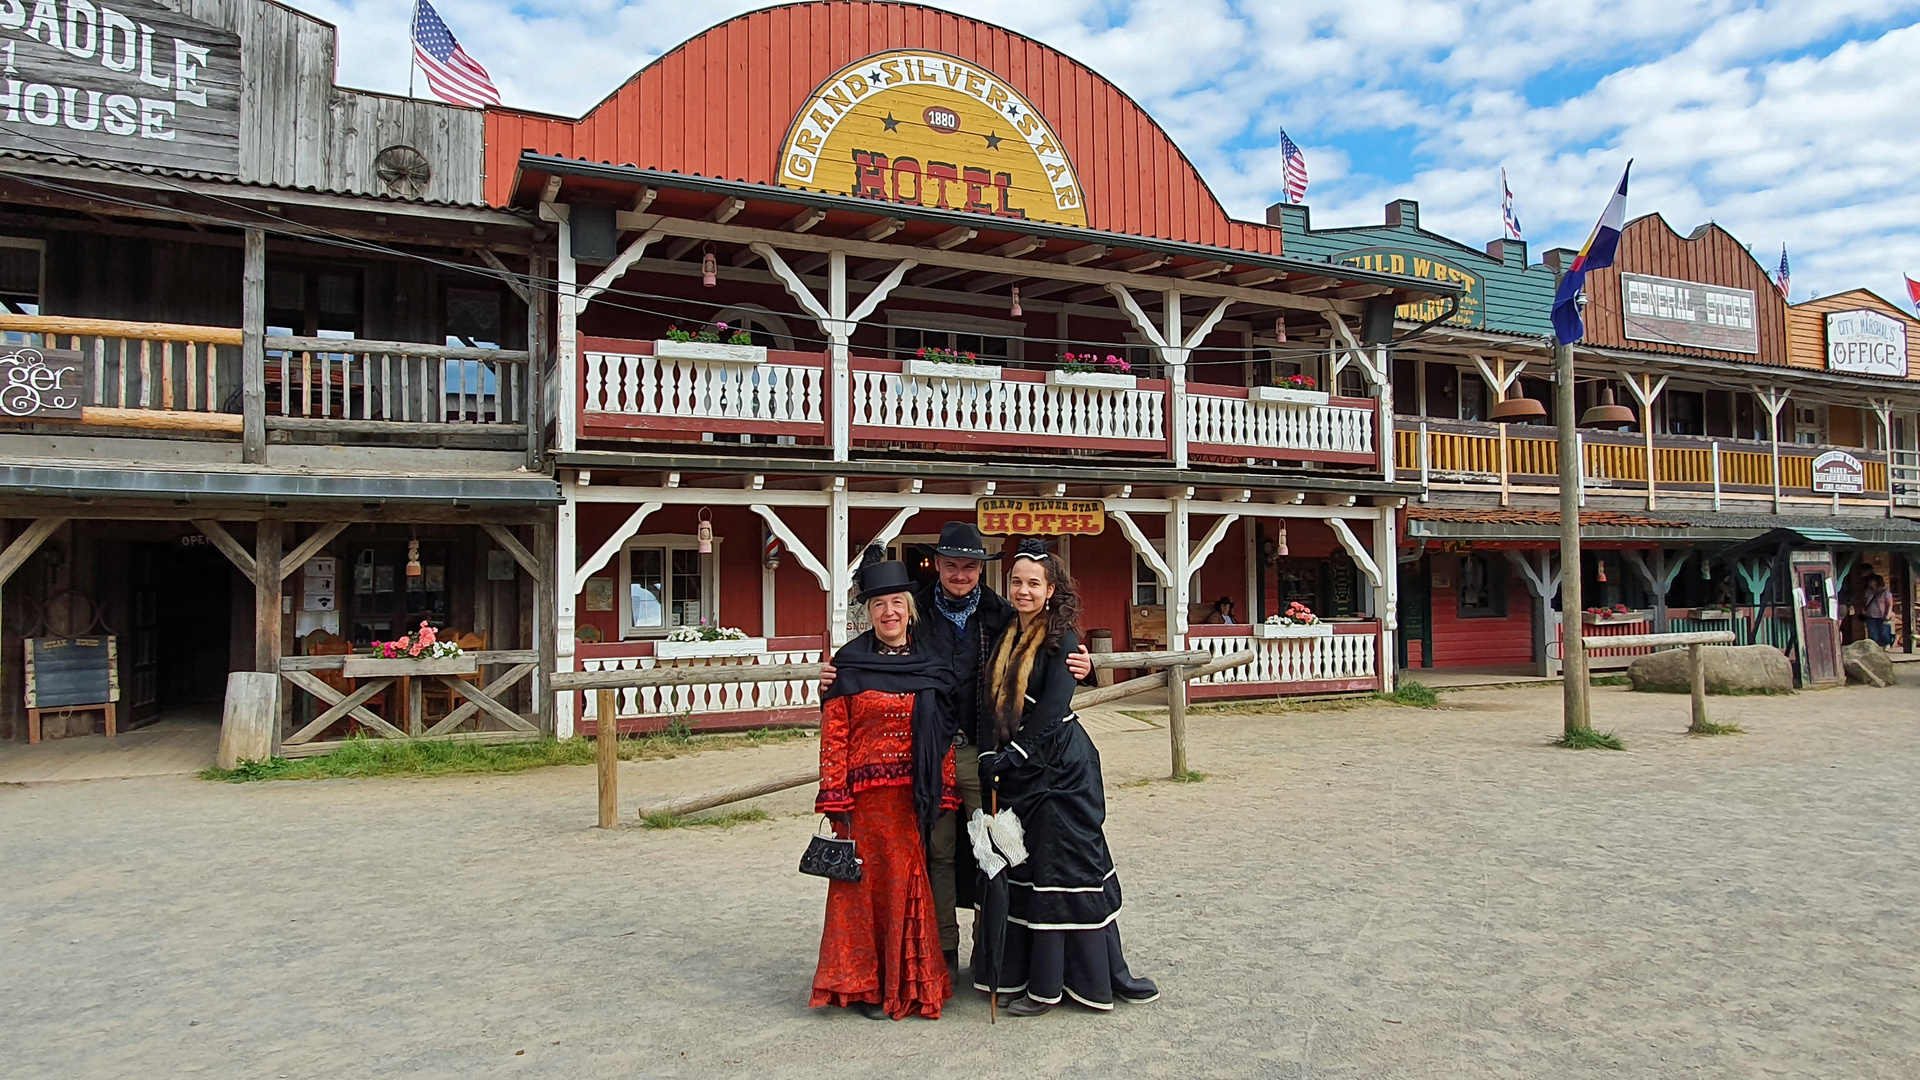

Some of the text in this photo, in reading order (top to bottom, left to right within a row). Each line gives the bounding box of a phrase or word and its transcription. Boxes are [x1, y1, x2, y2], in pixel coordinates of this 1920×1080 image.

[0, 78, 176, 141] HOUSE
[927, 110, 955, 129] 1880
[788, 58, 1077, 209] GRAND SILVER STAR
[852, 148, 1026, 220] HOTEL
[1413, 257, 1476, 294] WEST
[1628, 280, 1752, 329] GENERAL STORE
[1837, 319, 1854, 335] CITY
[1833, 341, 1902, 371] OFFICE
[982, 500, 1099, 512] GRAND SILVER STAR
[982, 513, 1100, 532] HOTEL
